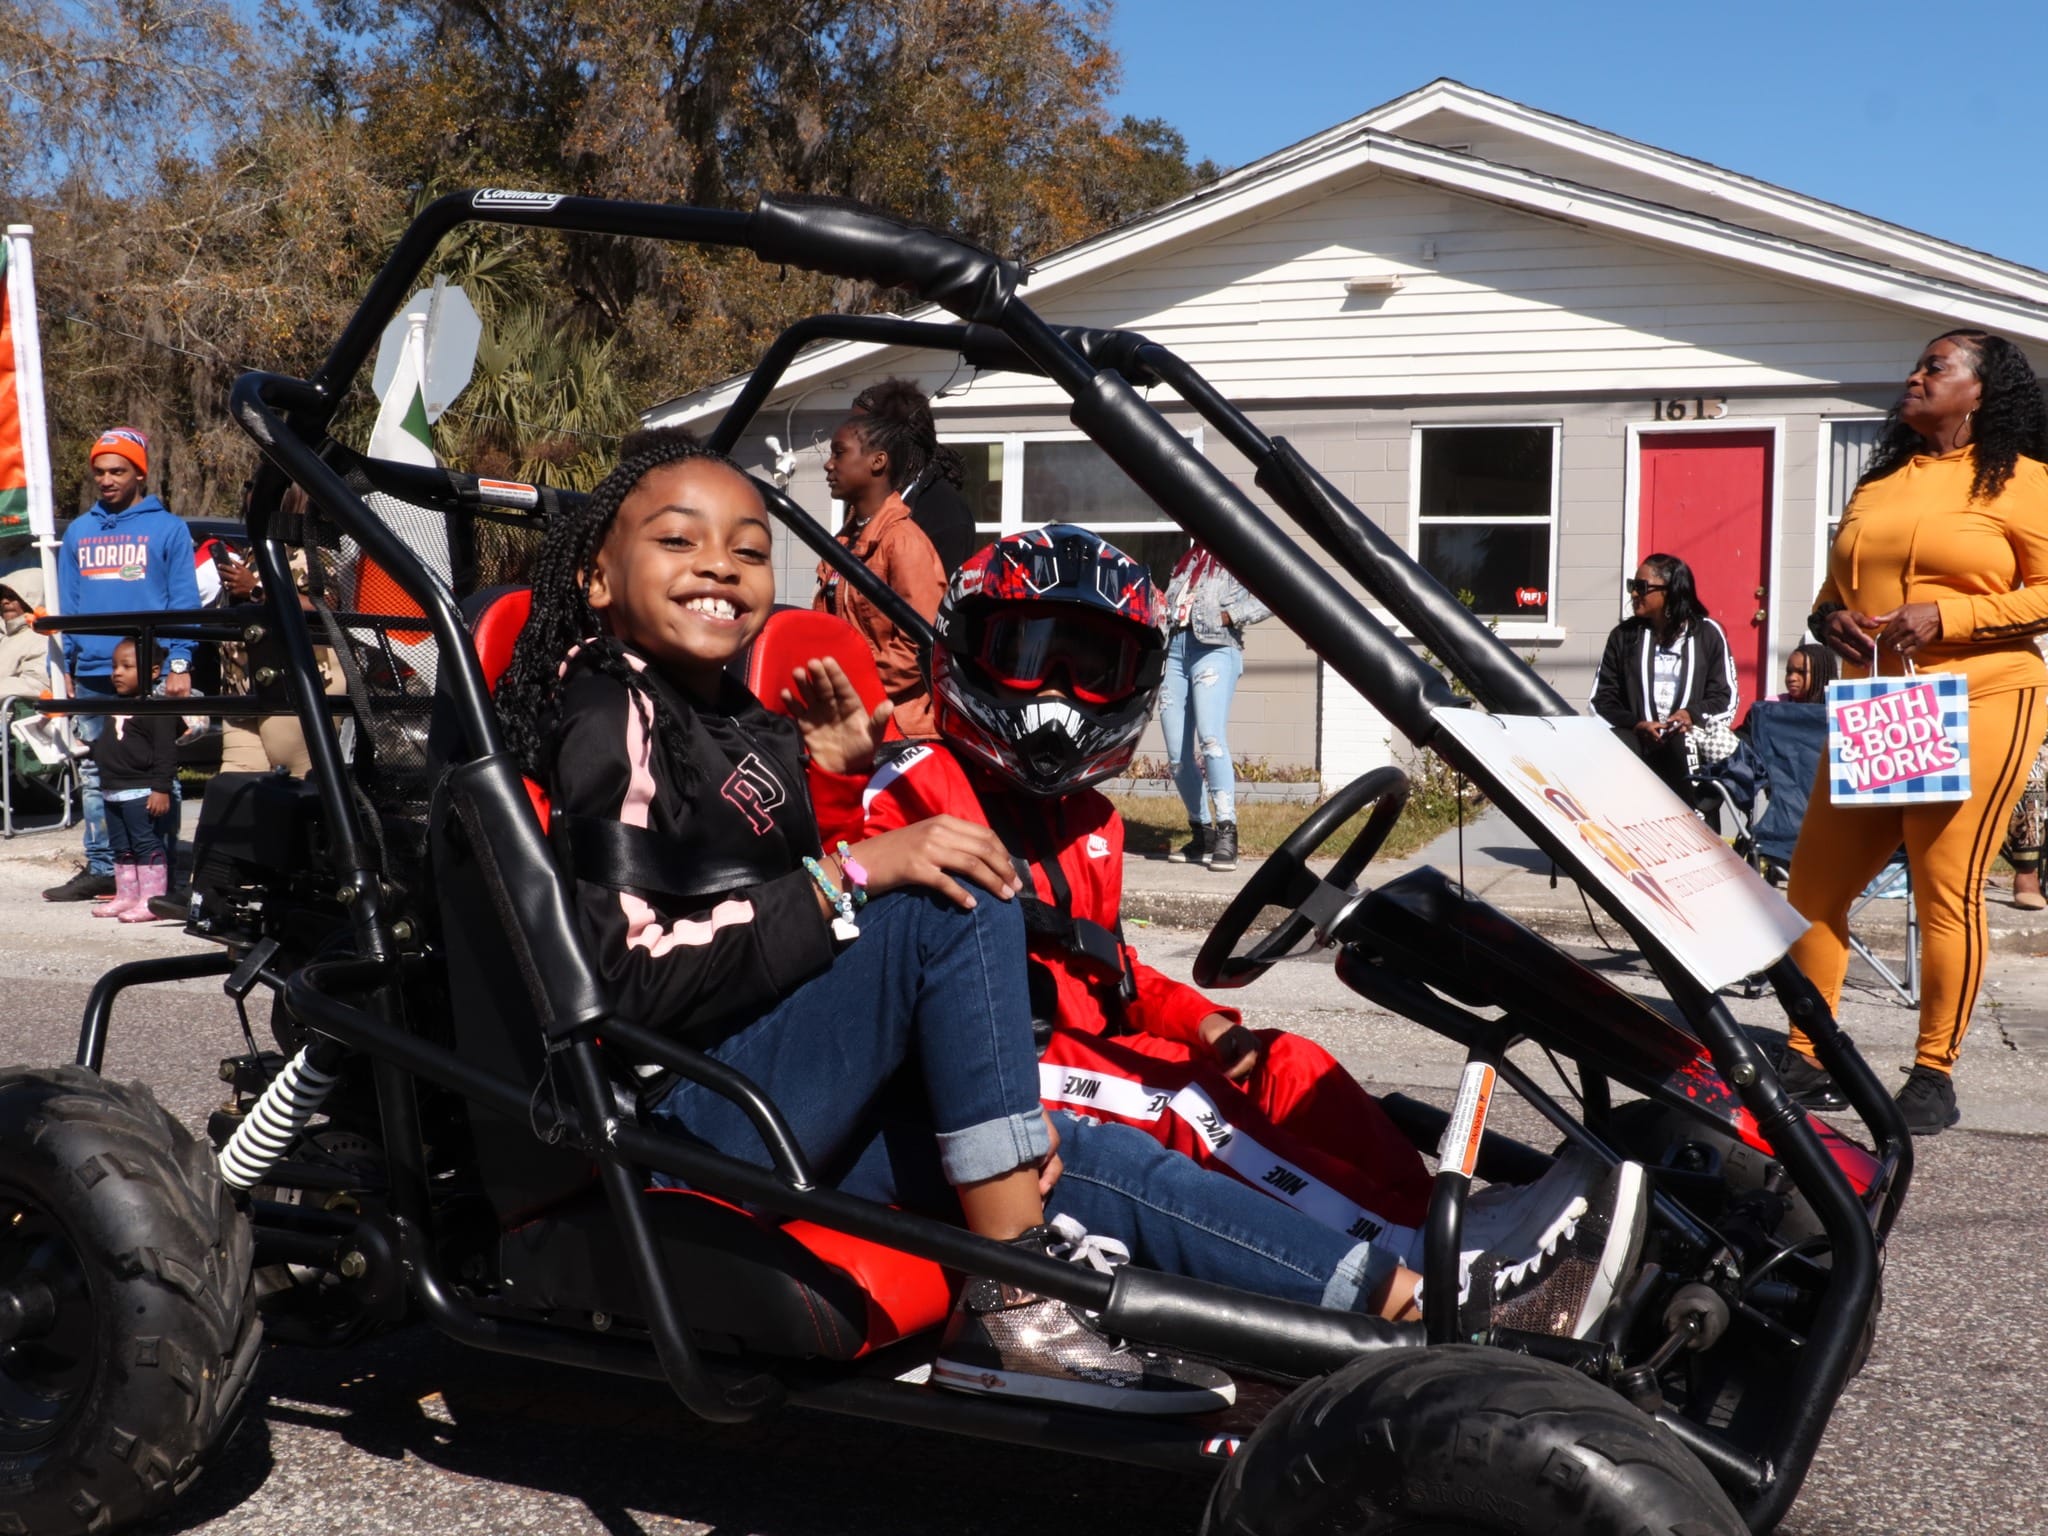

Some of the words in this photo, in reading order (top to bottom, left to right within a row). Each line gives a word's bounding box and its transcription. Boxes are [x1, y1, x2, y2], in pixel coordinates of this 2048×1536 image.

[1652, 396, 1728, 421] 1613
[78, 543, 147, 568] FLORIDA
[1843, 688, 1929, 733] BATH
[1840, 736, 1864, 762] &
[1861, 711, 1946, 757] BODY
[1843, 737, 1960, 789] WORKS
[1063, 1075, 1101, 1099] NIKE
[1196, 1111, 1233, 1149] NIKE
[1261, 1165, 1309, 1196] NIKE
